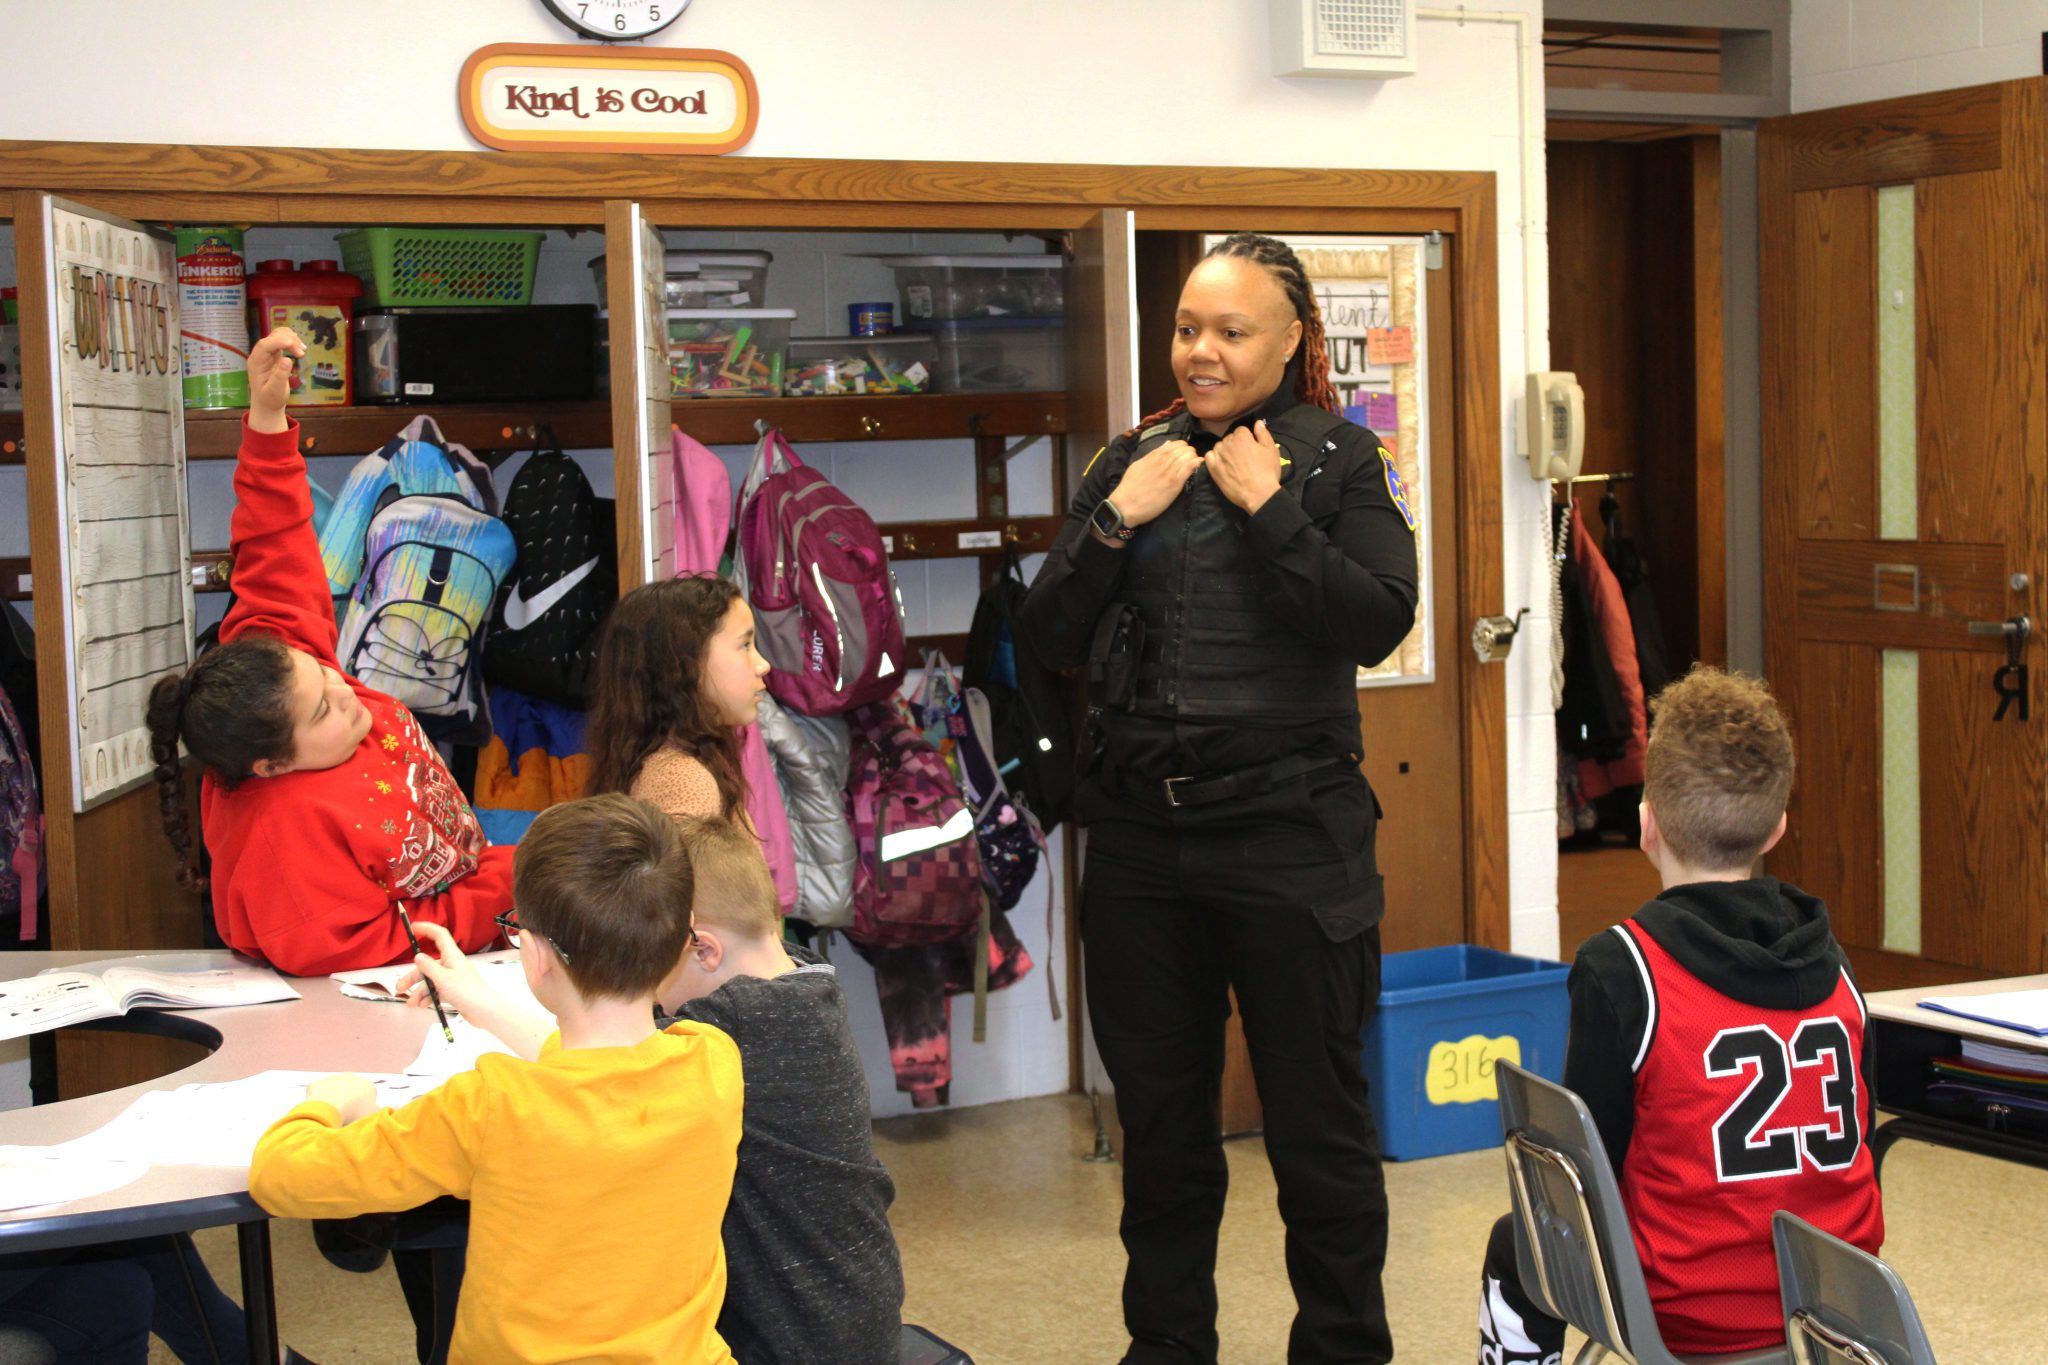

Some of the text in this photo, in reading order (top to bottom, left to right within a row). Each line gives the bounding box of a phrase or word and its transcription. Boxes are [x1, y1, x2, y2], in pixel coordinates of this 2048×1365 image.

[577, 3, 589, 20] 7
[614, 14, 627, 31] 6
[649, 5, 661, 22] 5
[505, 84, 708, 119] Kind is Cool
[72, 265, 169, 376] WRITING
[1321, 287, 1387, 329] dent
[1442, 1046, 1495, 1090] 316
[1703, 1016, 1861, 1182] 23
